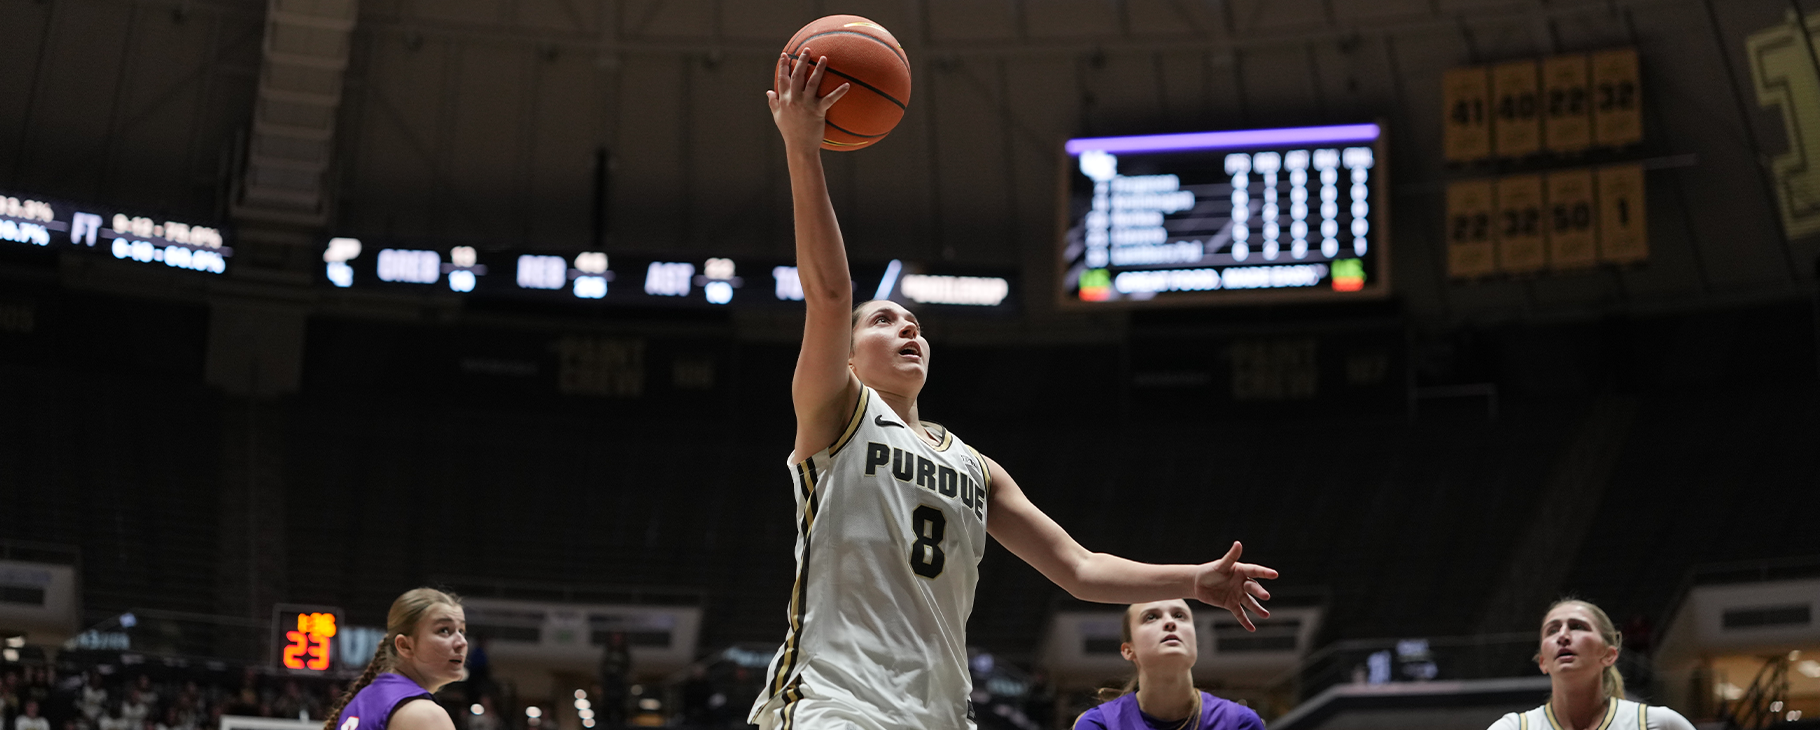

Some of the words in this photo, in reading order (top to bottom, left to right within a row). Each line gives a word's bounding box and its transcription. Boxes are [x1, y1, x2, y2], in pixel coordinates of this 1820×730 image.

[1451, 98, 1485, 125] 41
[1498, 94, 1537, 120] 40
[1548, 87, 1587, 117] 22
[1596, 81, 1635, 112] 32
[71, 212, 102, 246] FT
[1453, 212, 1489, 243] 22
[1504, 207, 1540, 237] 32
[1552, 201, 1591, 233] 50
[643, 262, 693, 297] AST
[864, 441, 985, 525] PURDUE
[910, 503, 946, 580] 8
[283, 630, 330, 670] 23
